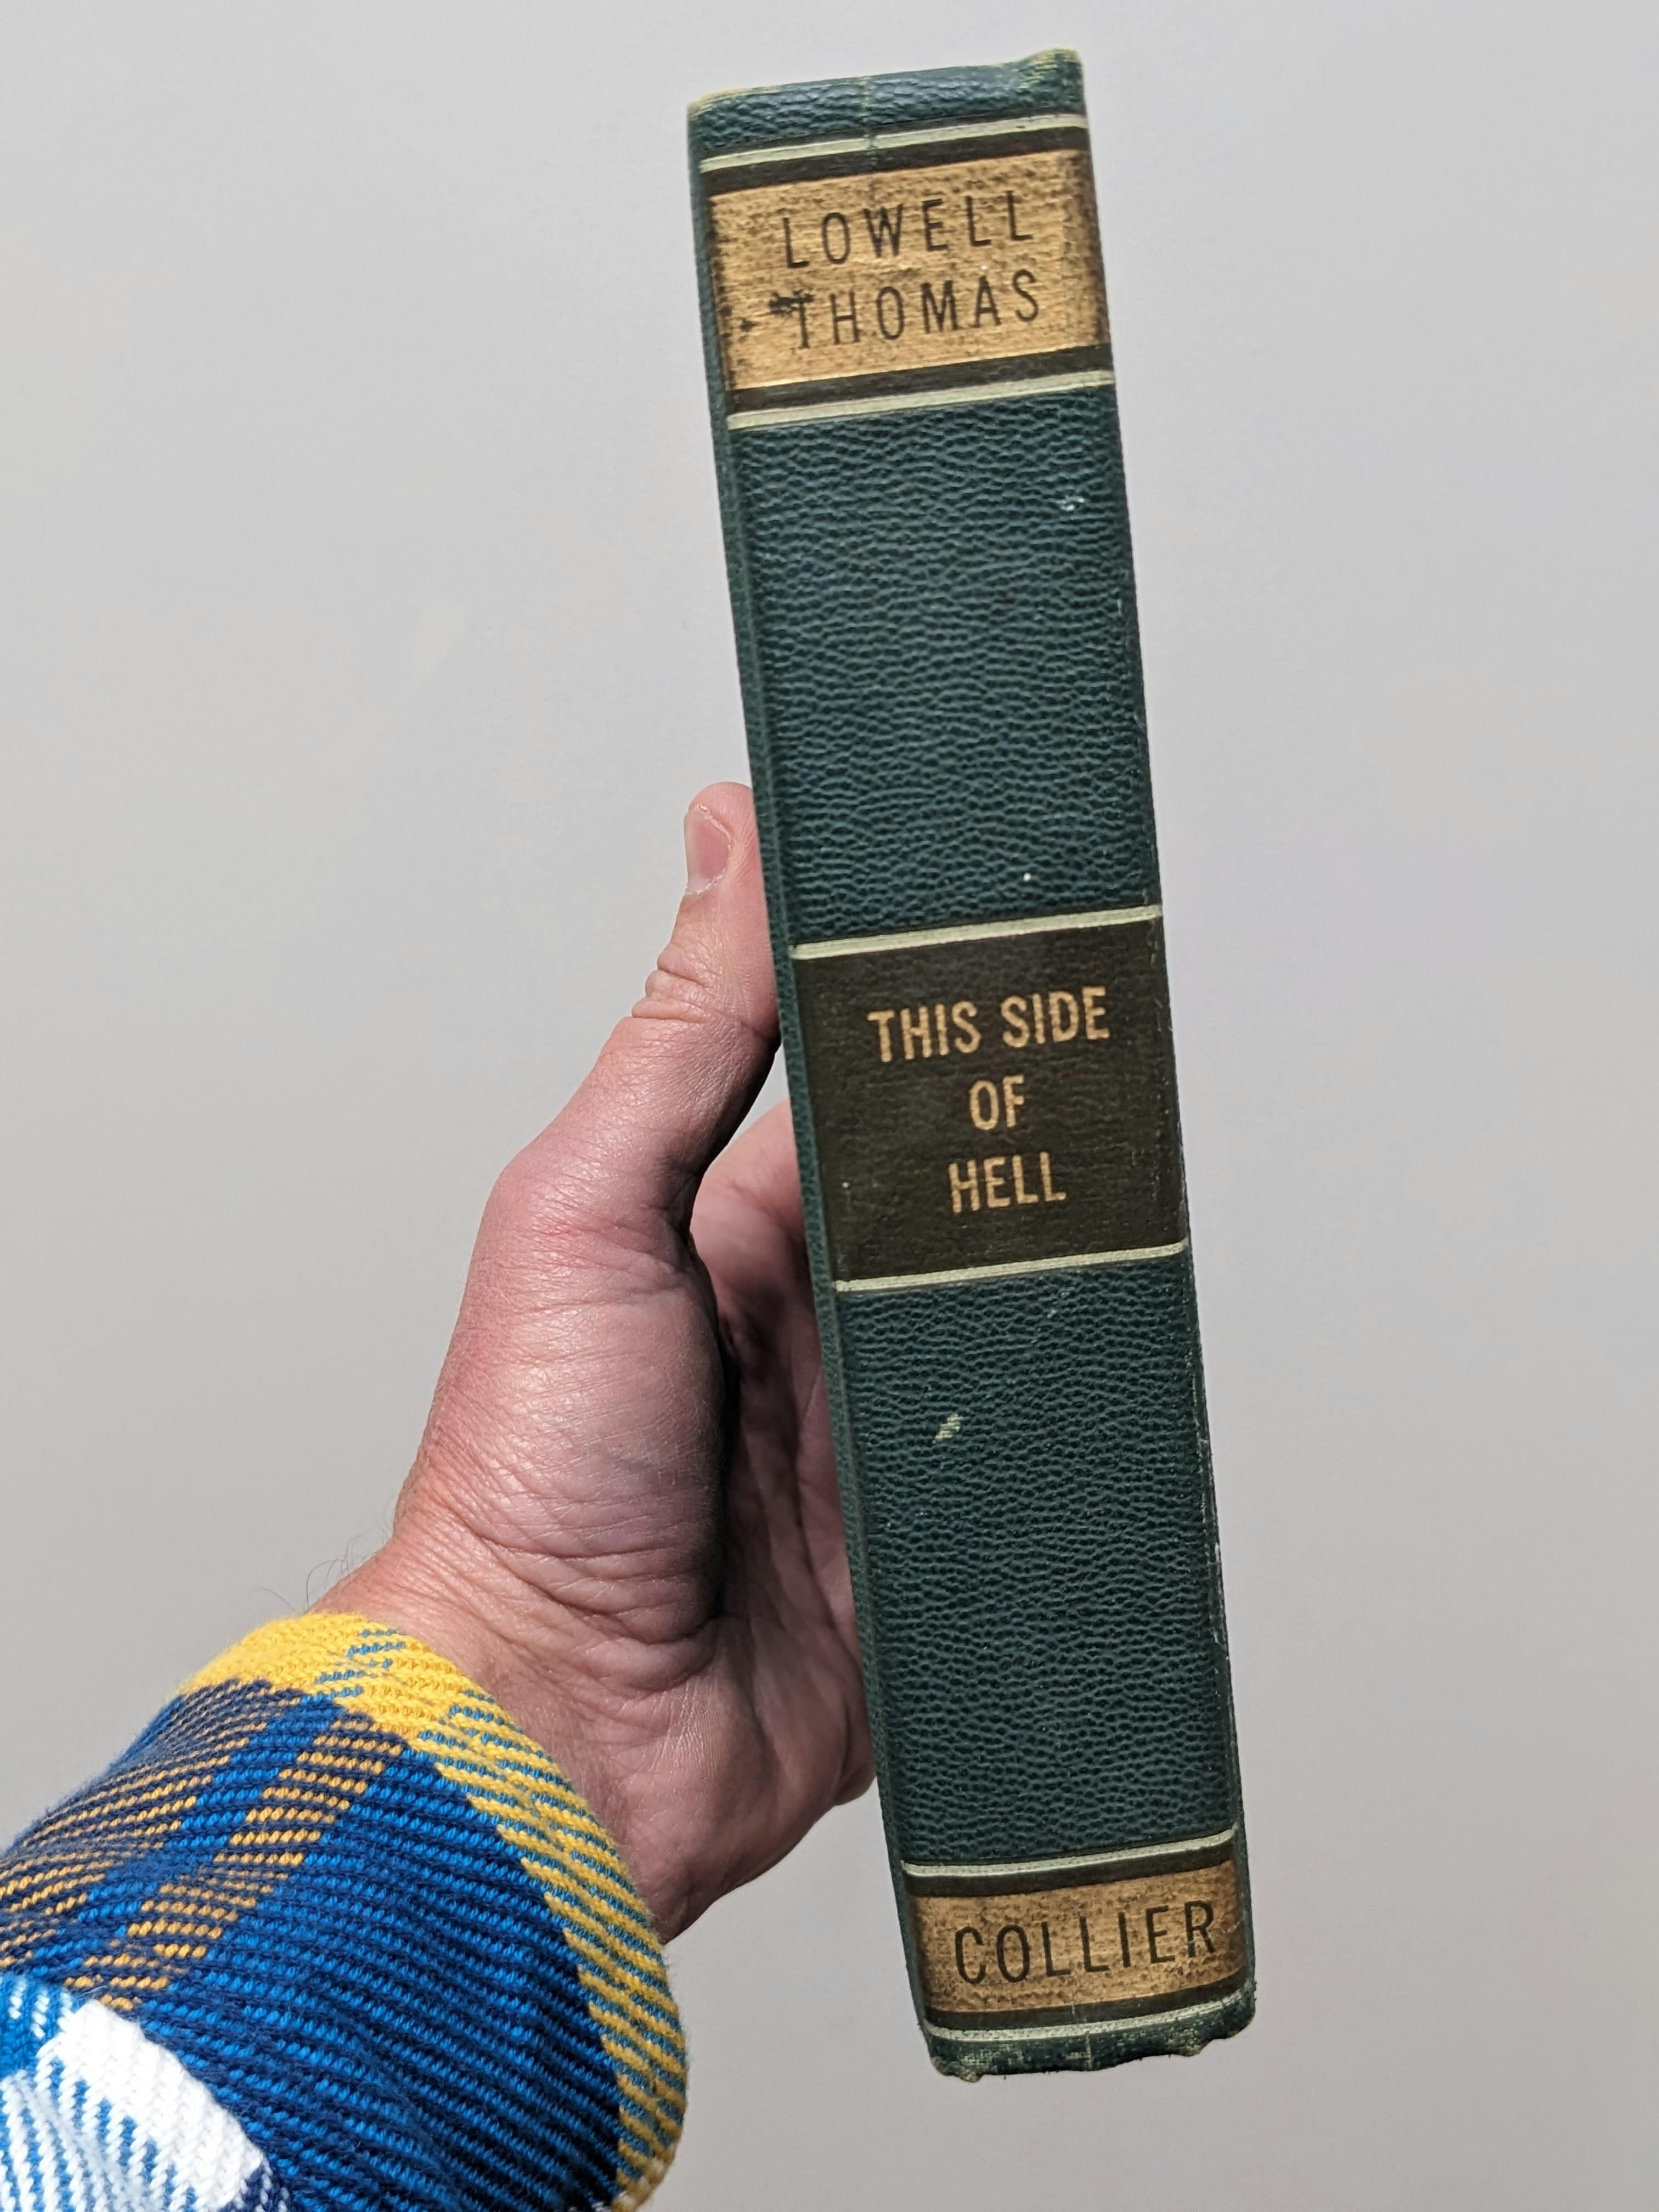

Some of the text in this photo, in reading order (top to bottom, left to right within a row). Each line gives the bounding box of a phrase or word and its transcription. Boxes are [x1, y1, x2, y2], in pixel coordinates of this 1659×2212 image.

[782, 189, 1034, 269] LOWELL
[793, 269, 1041, 349] THOMAS
[867, 986, 1110, 1063] THIS SIDE
[968, 1074, 1026, 1131] OF
[948, 1151, 1067, 1214] HELL
[954, 1899, 1216, 1985] COLLIER
